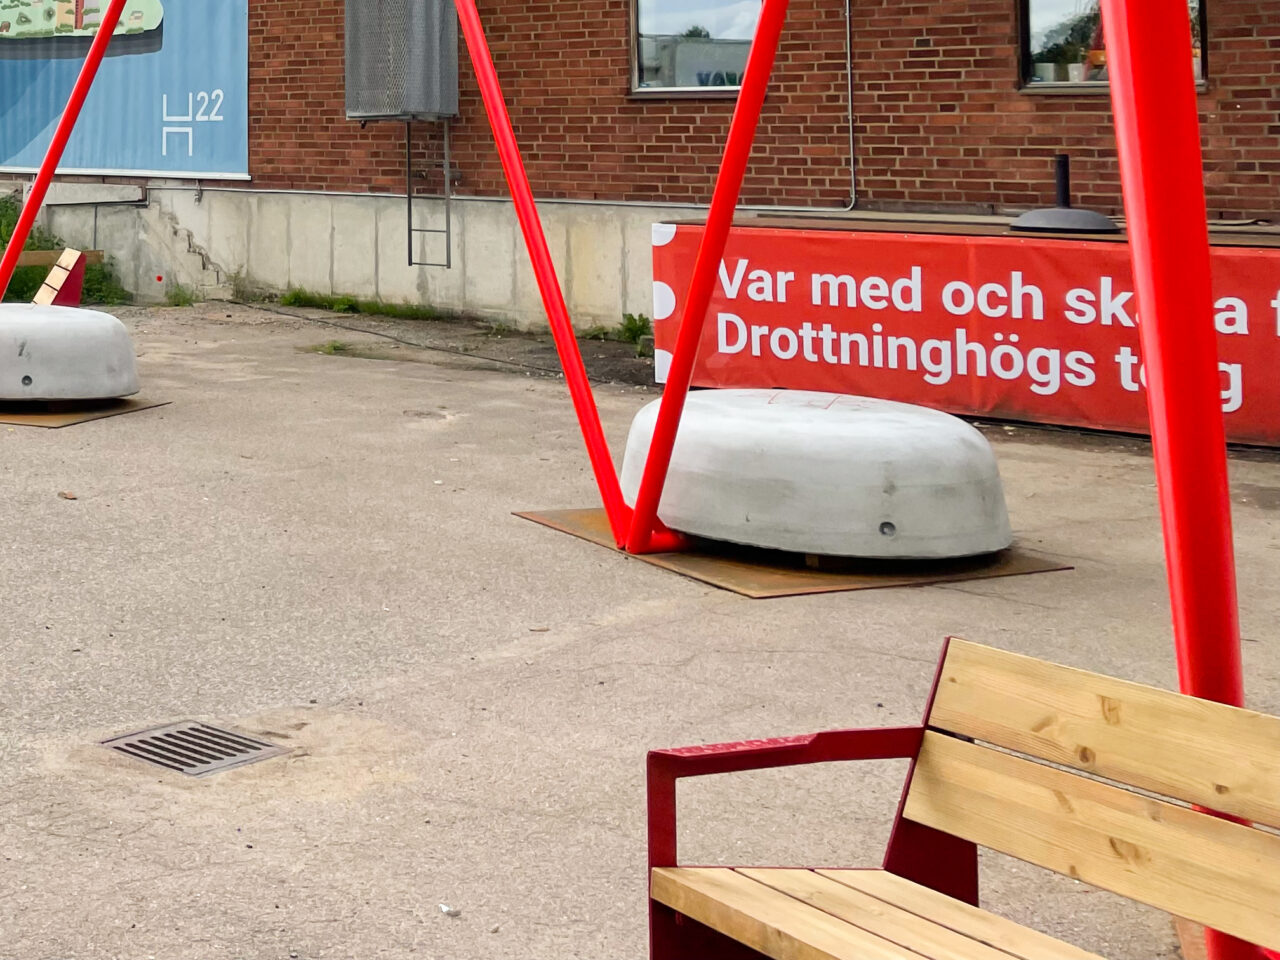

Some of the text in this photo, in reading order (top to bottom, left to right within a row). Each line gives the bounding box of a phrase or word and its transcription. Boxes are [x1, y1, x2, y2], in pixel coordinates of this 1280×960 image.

[718, 258, 795, 303] Var
[811, 265, 922, 312] med
[941, 270, 1044, 320] och
[1063, 276, 1249, 335] ska
[716, 312, 1243, 413] Drottninghögs tg
